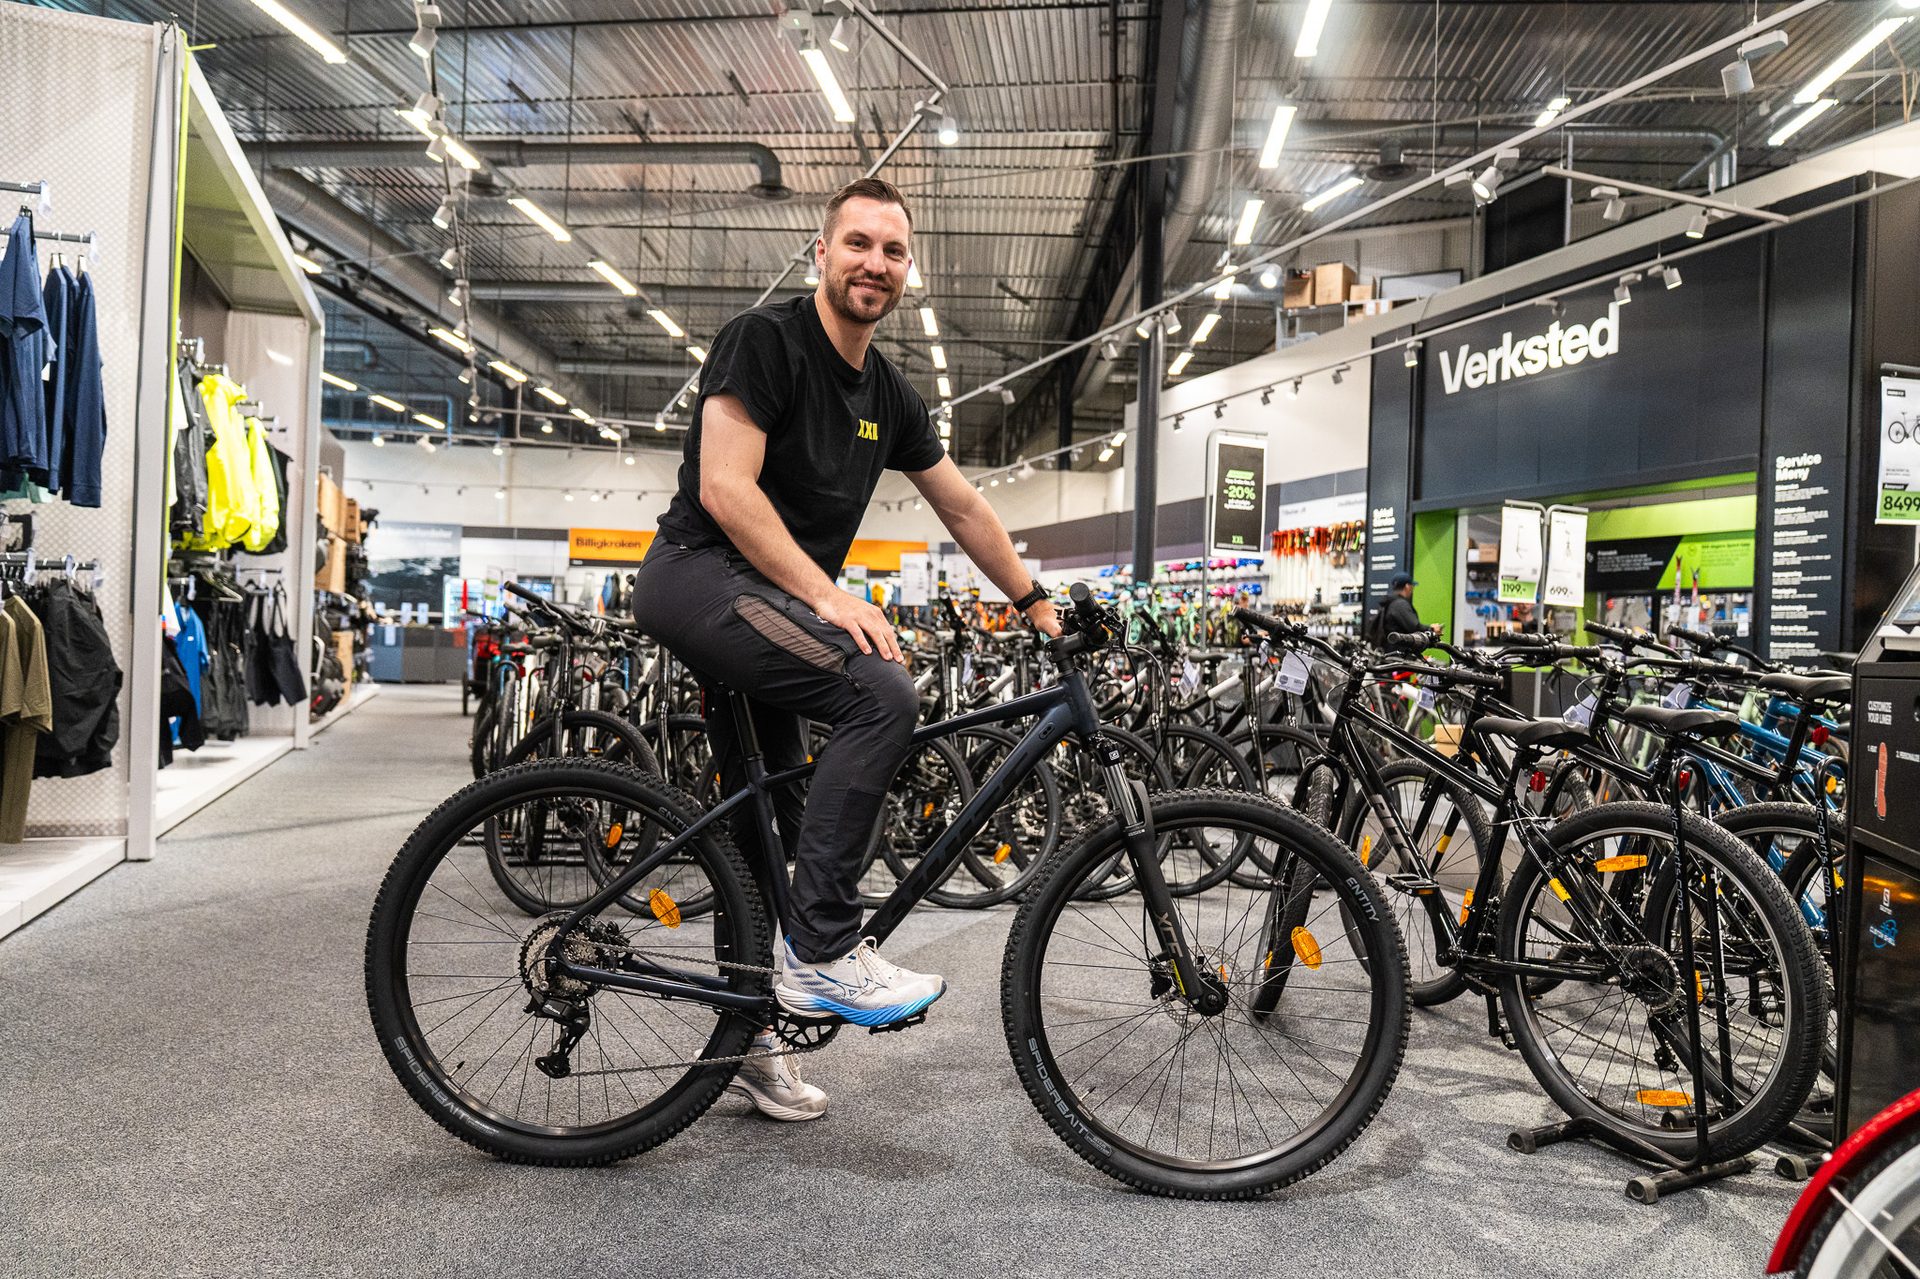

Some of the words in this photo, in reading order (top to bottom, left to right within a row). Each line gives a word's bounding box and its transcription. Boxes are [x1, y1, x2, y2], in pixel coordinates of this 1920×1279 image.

[1439, 301, 1620, 395] Verksted
[857, 418, 878, 441] XXL
[1776, 453, 1822, 469] Service
[1223, 485, 1256, 500] -20%
[576, 536, 642, 550] Billigkroken
[659, 806, 690, 831] ENTI
[1816, 799, 1832, 897] xlc-parts.com
[1346, 877, 1380, 921] ENTITY
[394, 1036, 470, 1120] SPIDERBAIT
[1028, 1037, 1089, 1134] SPIDERBAIT
